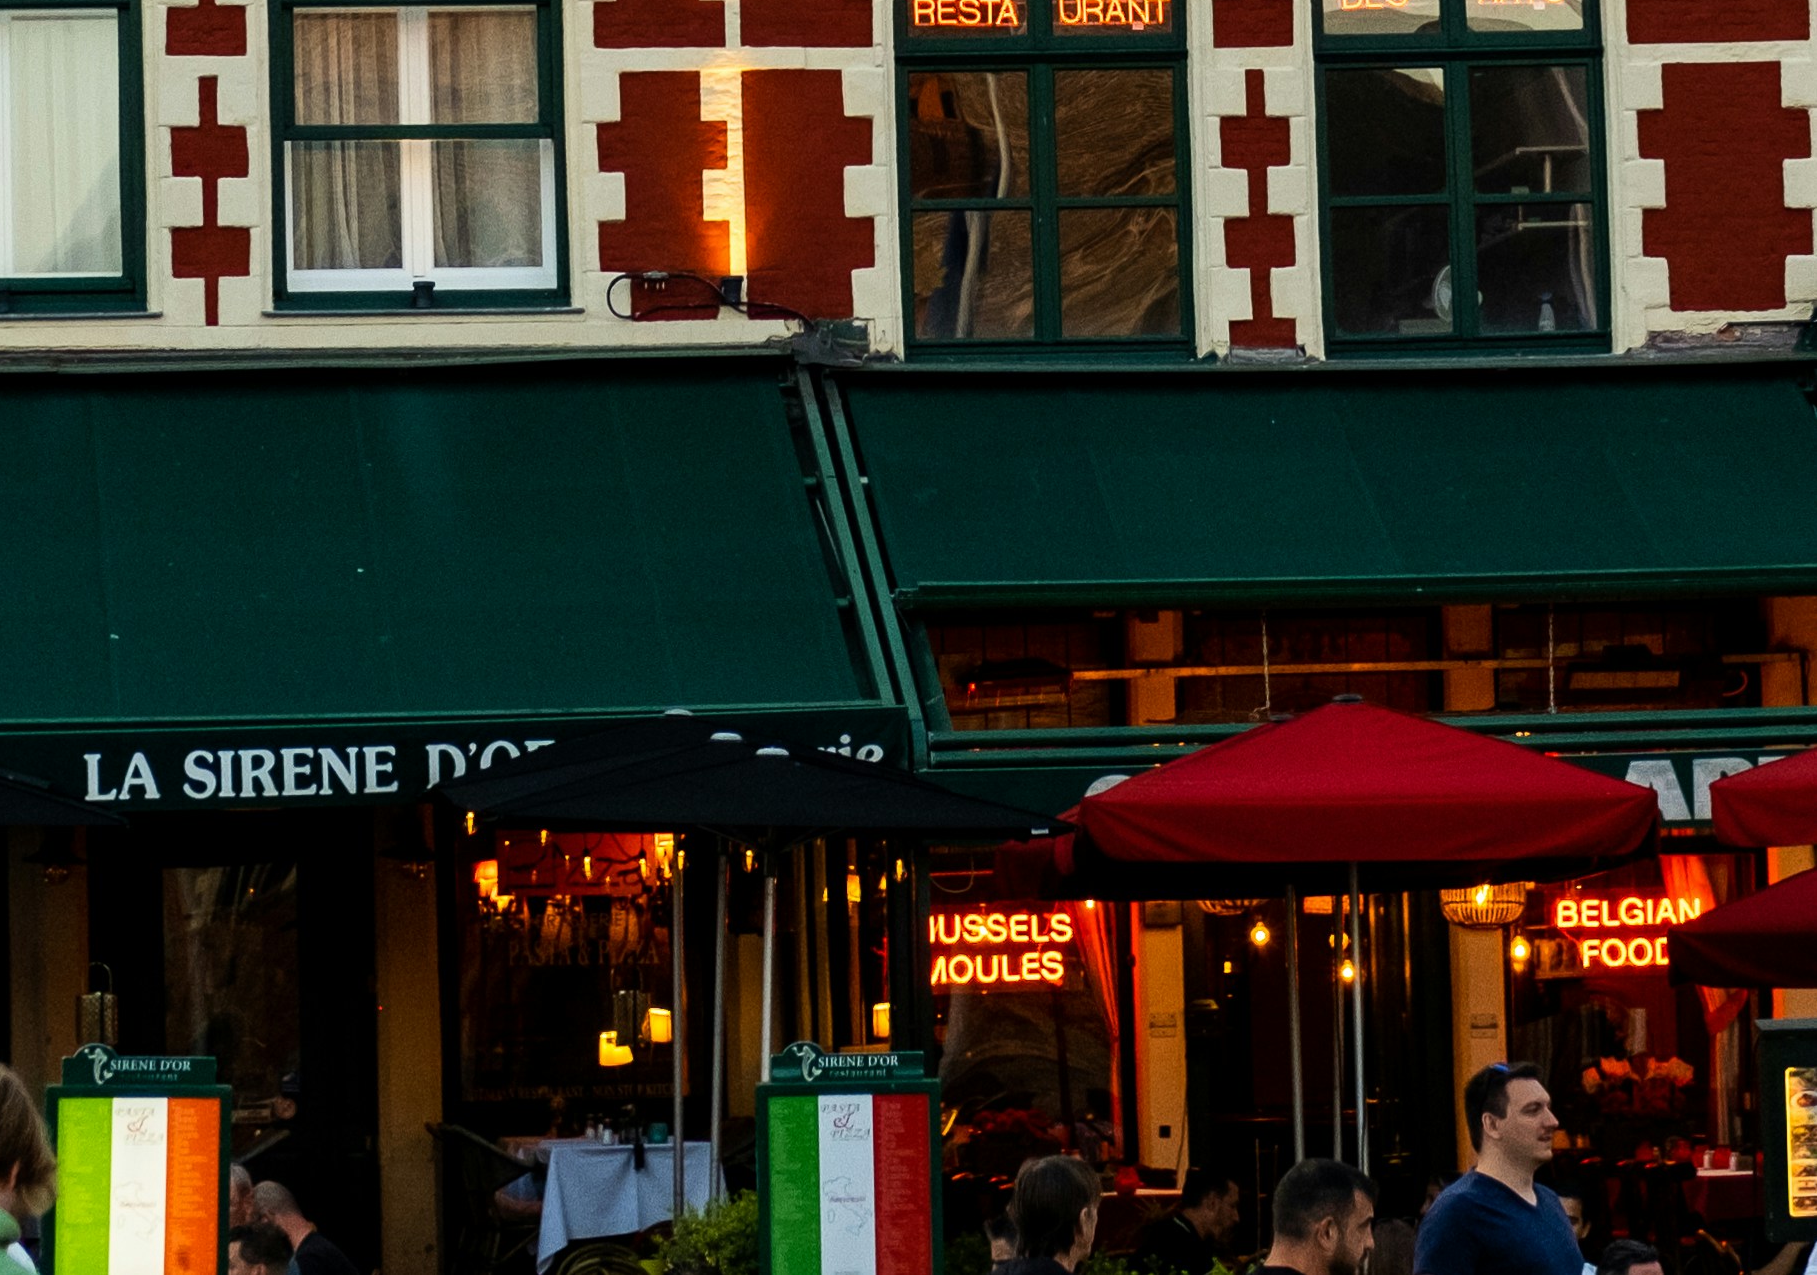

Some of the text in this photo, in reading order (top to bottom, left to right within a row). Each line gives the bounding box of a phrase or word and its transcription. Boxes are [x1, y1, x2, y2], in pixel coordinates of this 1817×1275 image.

[83, 740, 555, 800] LA SIRENE D'O
[1557, 897, 1701, 928] BELGIAN
[110, 1060, 191, 1071] SIRENE D'OR
[818, 1055, 899, 1068] SIRENE D'OR
